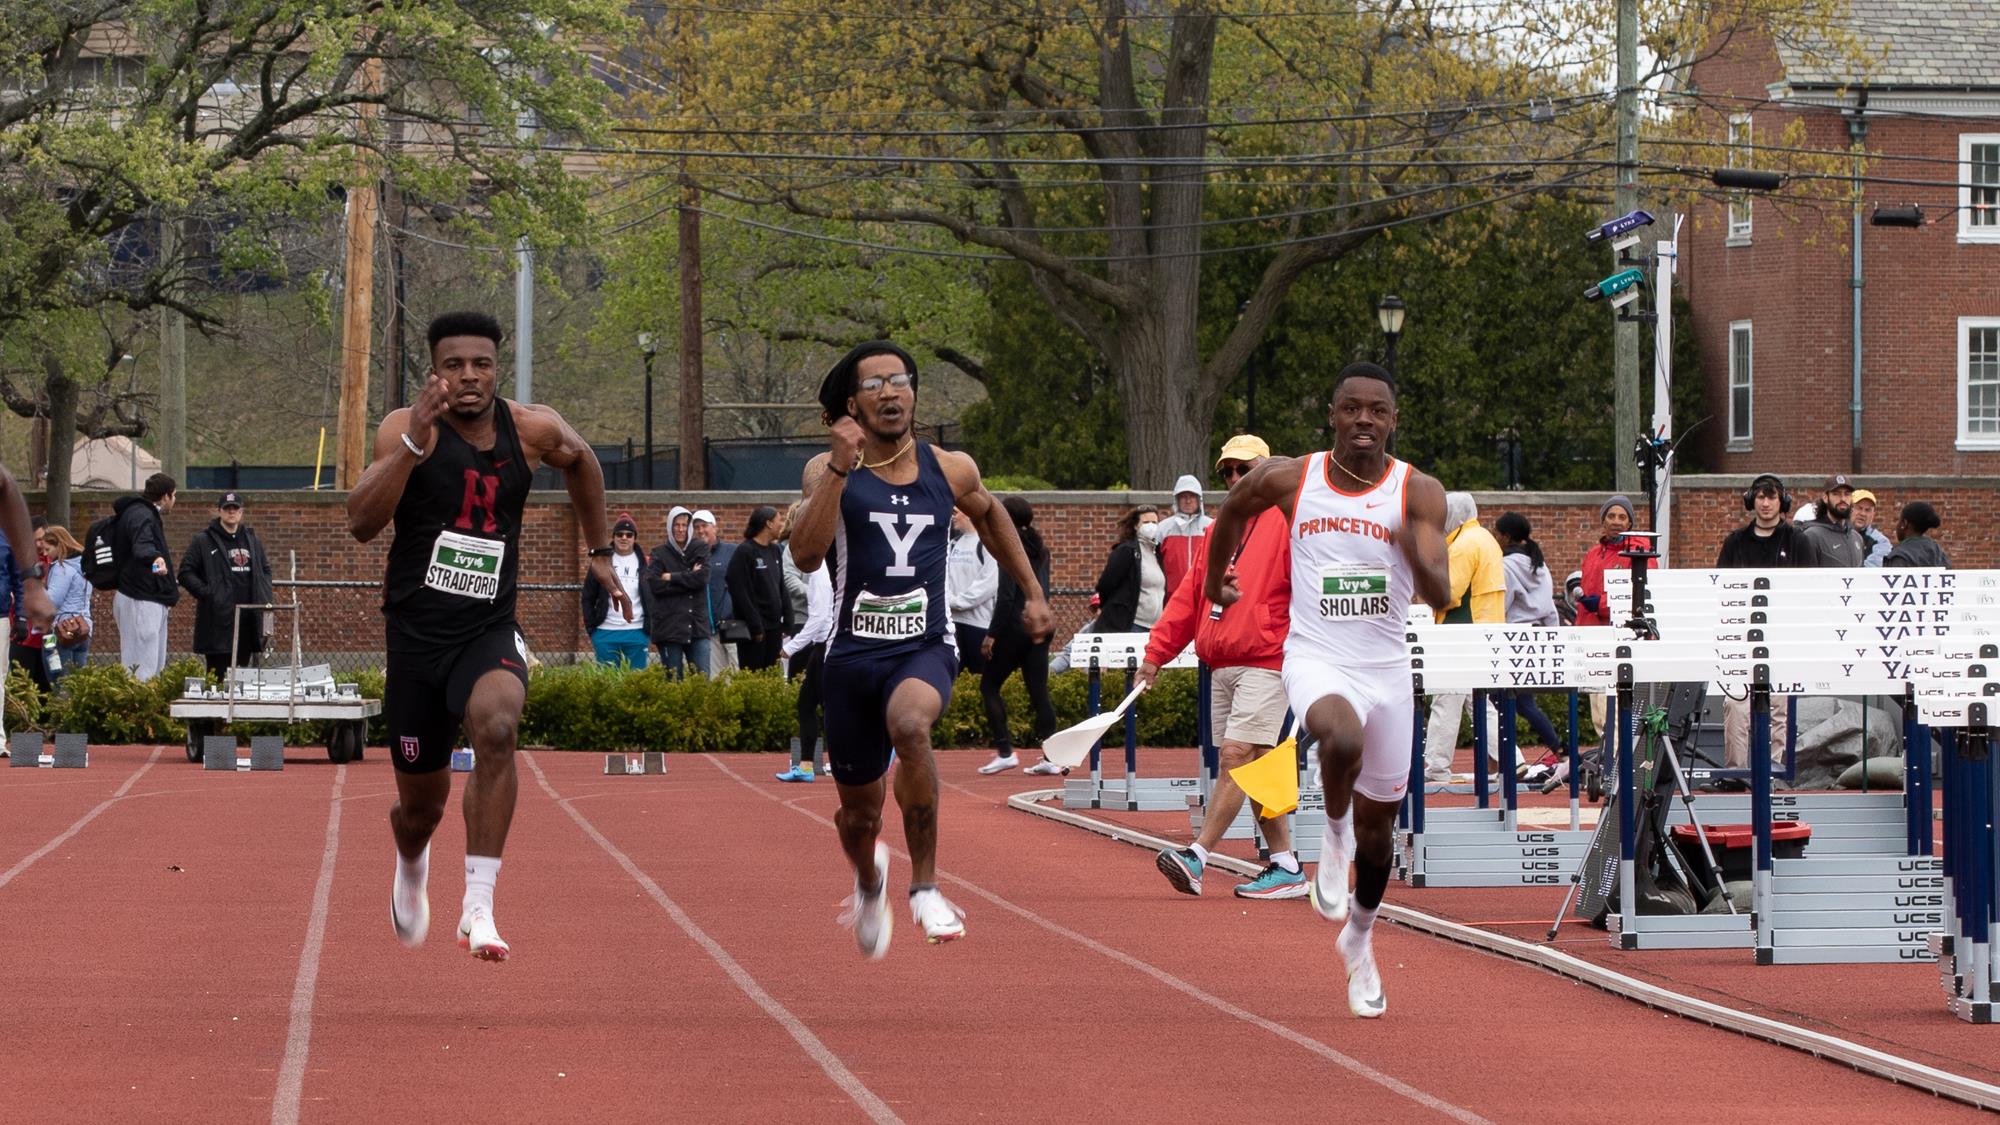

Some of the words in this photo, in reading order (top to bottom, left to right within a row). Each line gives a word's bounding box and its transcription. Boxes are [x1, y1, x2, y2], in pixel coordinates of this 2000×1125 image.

[455, 470, 499, 533] H
[1299, 517, 1394, 545] PRINCETON
[869, 512, 935, 577] Y
[453, 552, 475, 568] Ivy
[427, 565, 496, 596] STRADFORD
[1338, 578, 1359, 593] Ivy
[1320, 595, 1389, 617] SHOLARS
[854, 614, 924, 635] CHARLES
[1842, 664, 1853, 676] Y
[1882, 661, 1911, 679] YA
[1491, 674, 1499, 683] Y
[1509, 672, 1564, 685] YALE
[404, 743, 415, 756] H
[1771, 797, 1796, 806] CS
[1773, 812, 1799, 821] CS
[1517, 834, 1554, 842] UCS
[1522, 848, 1559, 856] UCS
[1522, 862, 1559, 870] UCS
[1898, 860, 1943, 871] UCS
[1522, 875, 1559, 883] UCS
[1898, 878, 1944, 888] UCS
[1895, 896, 1943, 906] UCS
[1894, 913, 1941, 923] UCS
[1898, 931, 1944, 941] UC
[1900, 949, 1939, 959] UC
